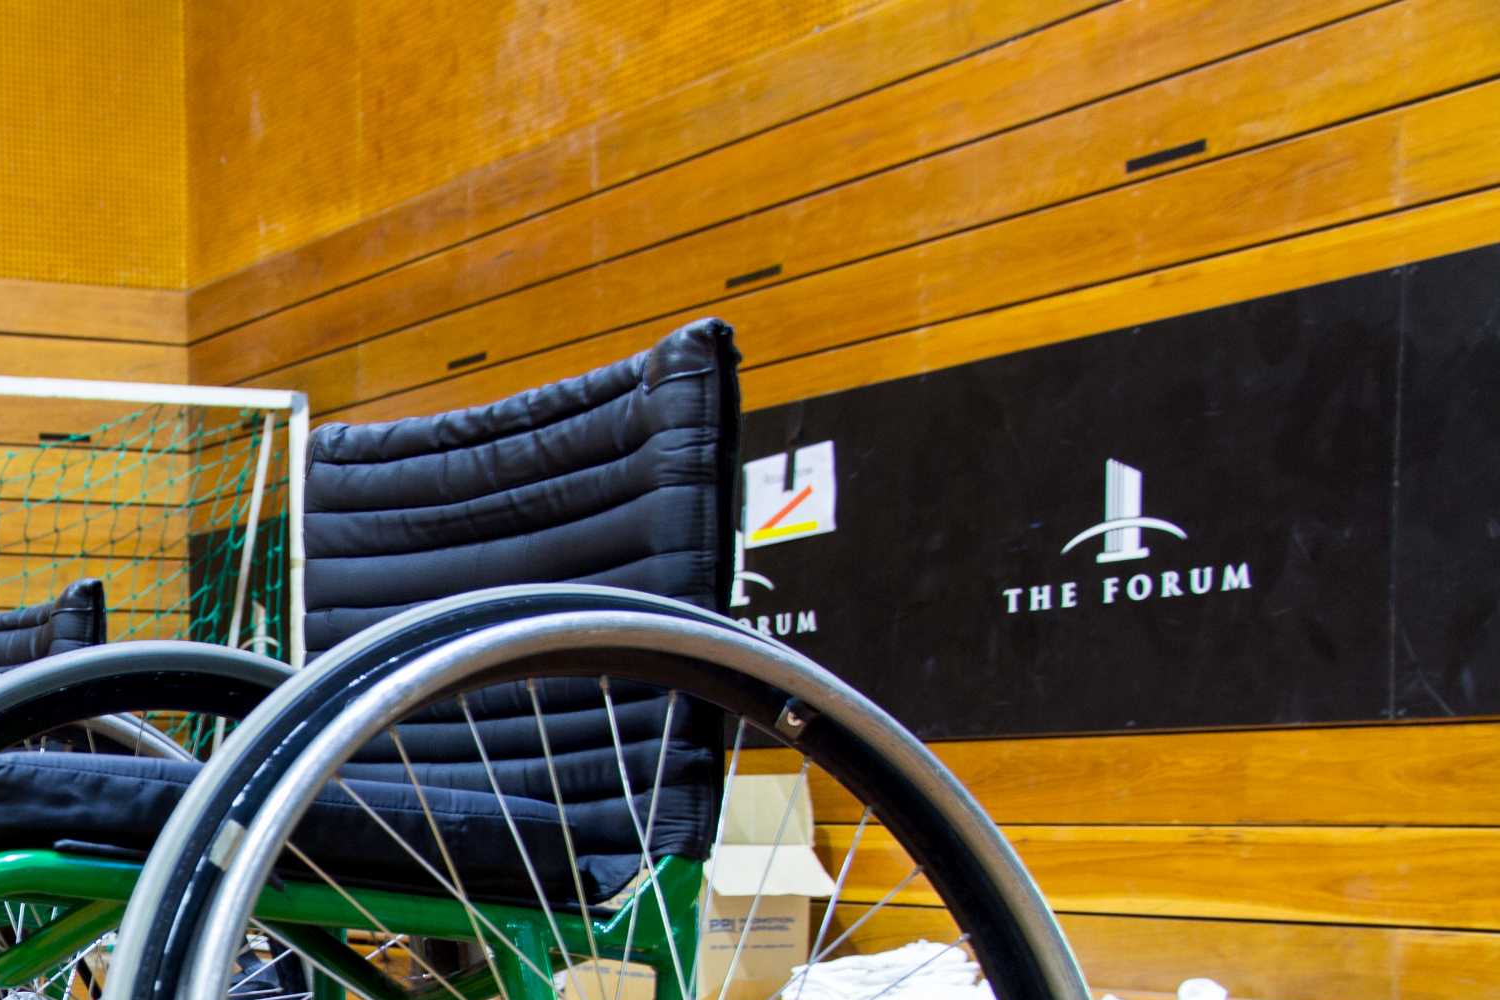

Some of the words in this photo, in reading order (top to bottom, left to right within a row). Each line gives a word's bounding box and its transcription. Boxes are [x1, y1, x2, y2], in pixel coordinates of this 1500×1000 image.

[1002, 581, 1078, 614] THE
[1102, 562, 1253, 604] FORUM
[737, 609, 818, 636] RUM
